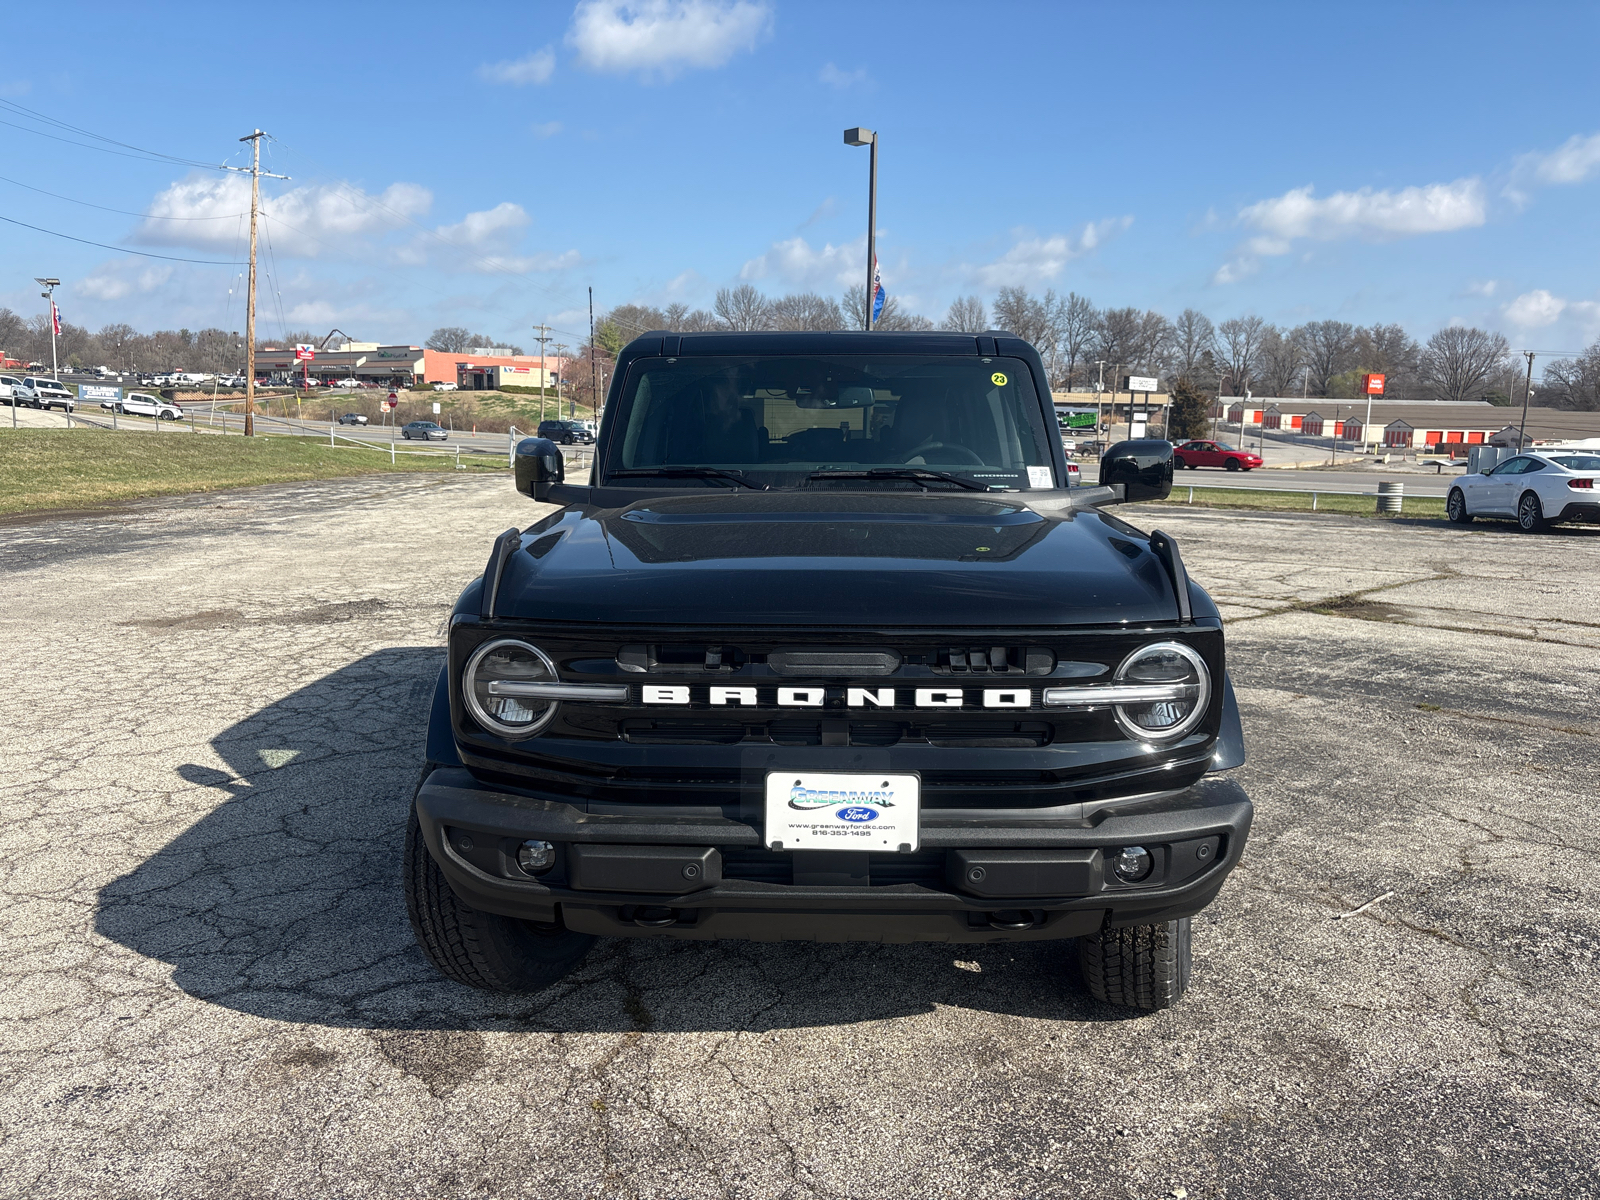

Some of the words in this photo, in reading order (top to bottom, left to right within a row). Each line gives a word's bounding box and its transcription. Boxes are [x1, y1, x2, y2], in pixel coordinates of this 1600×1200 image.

[993, 374, 1005, 384] 23
[642, 685, 1032, 707] BRONCO
[790, 786, 895, 805] GREENWAY
[844, 807, 870, 820] Ford
